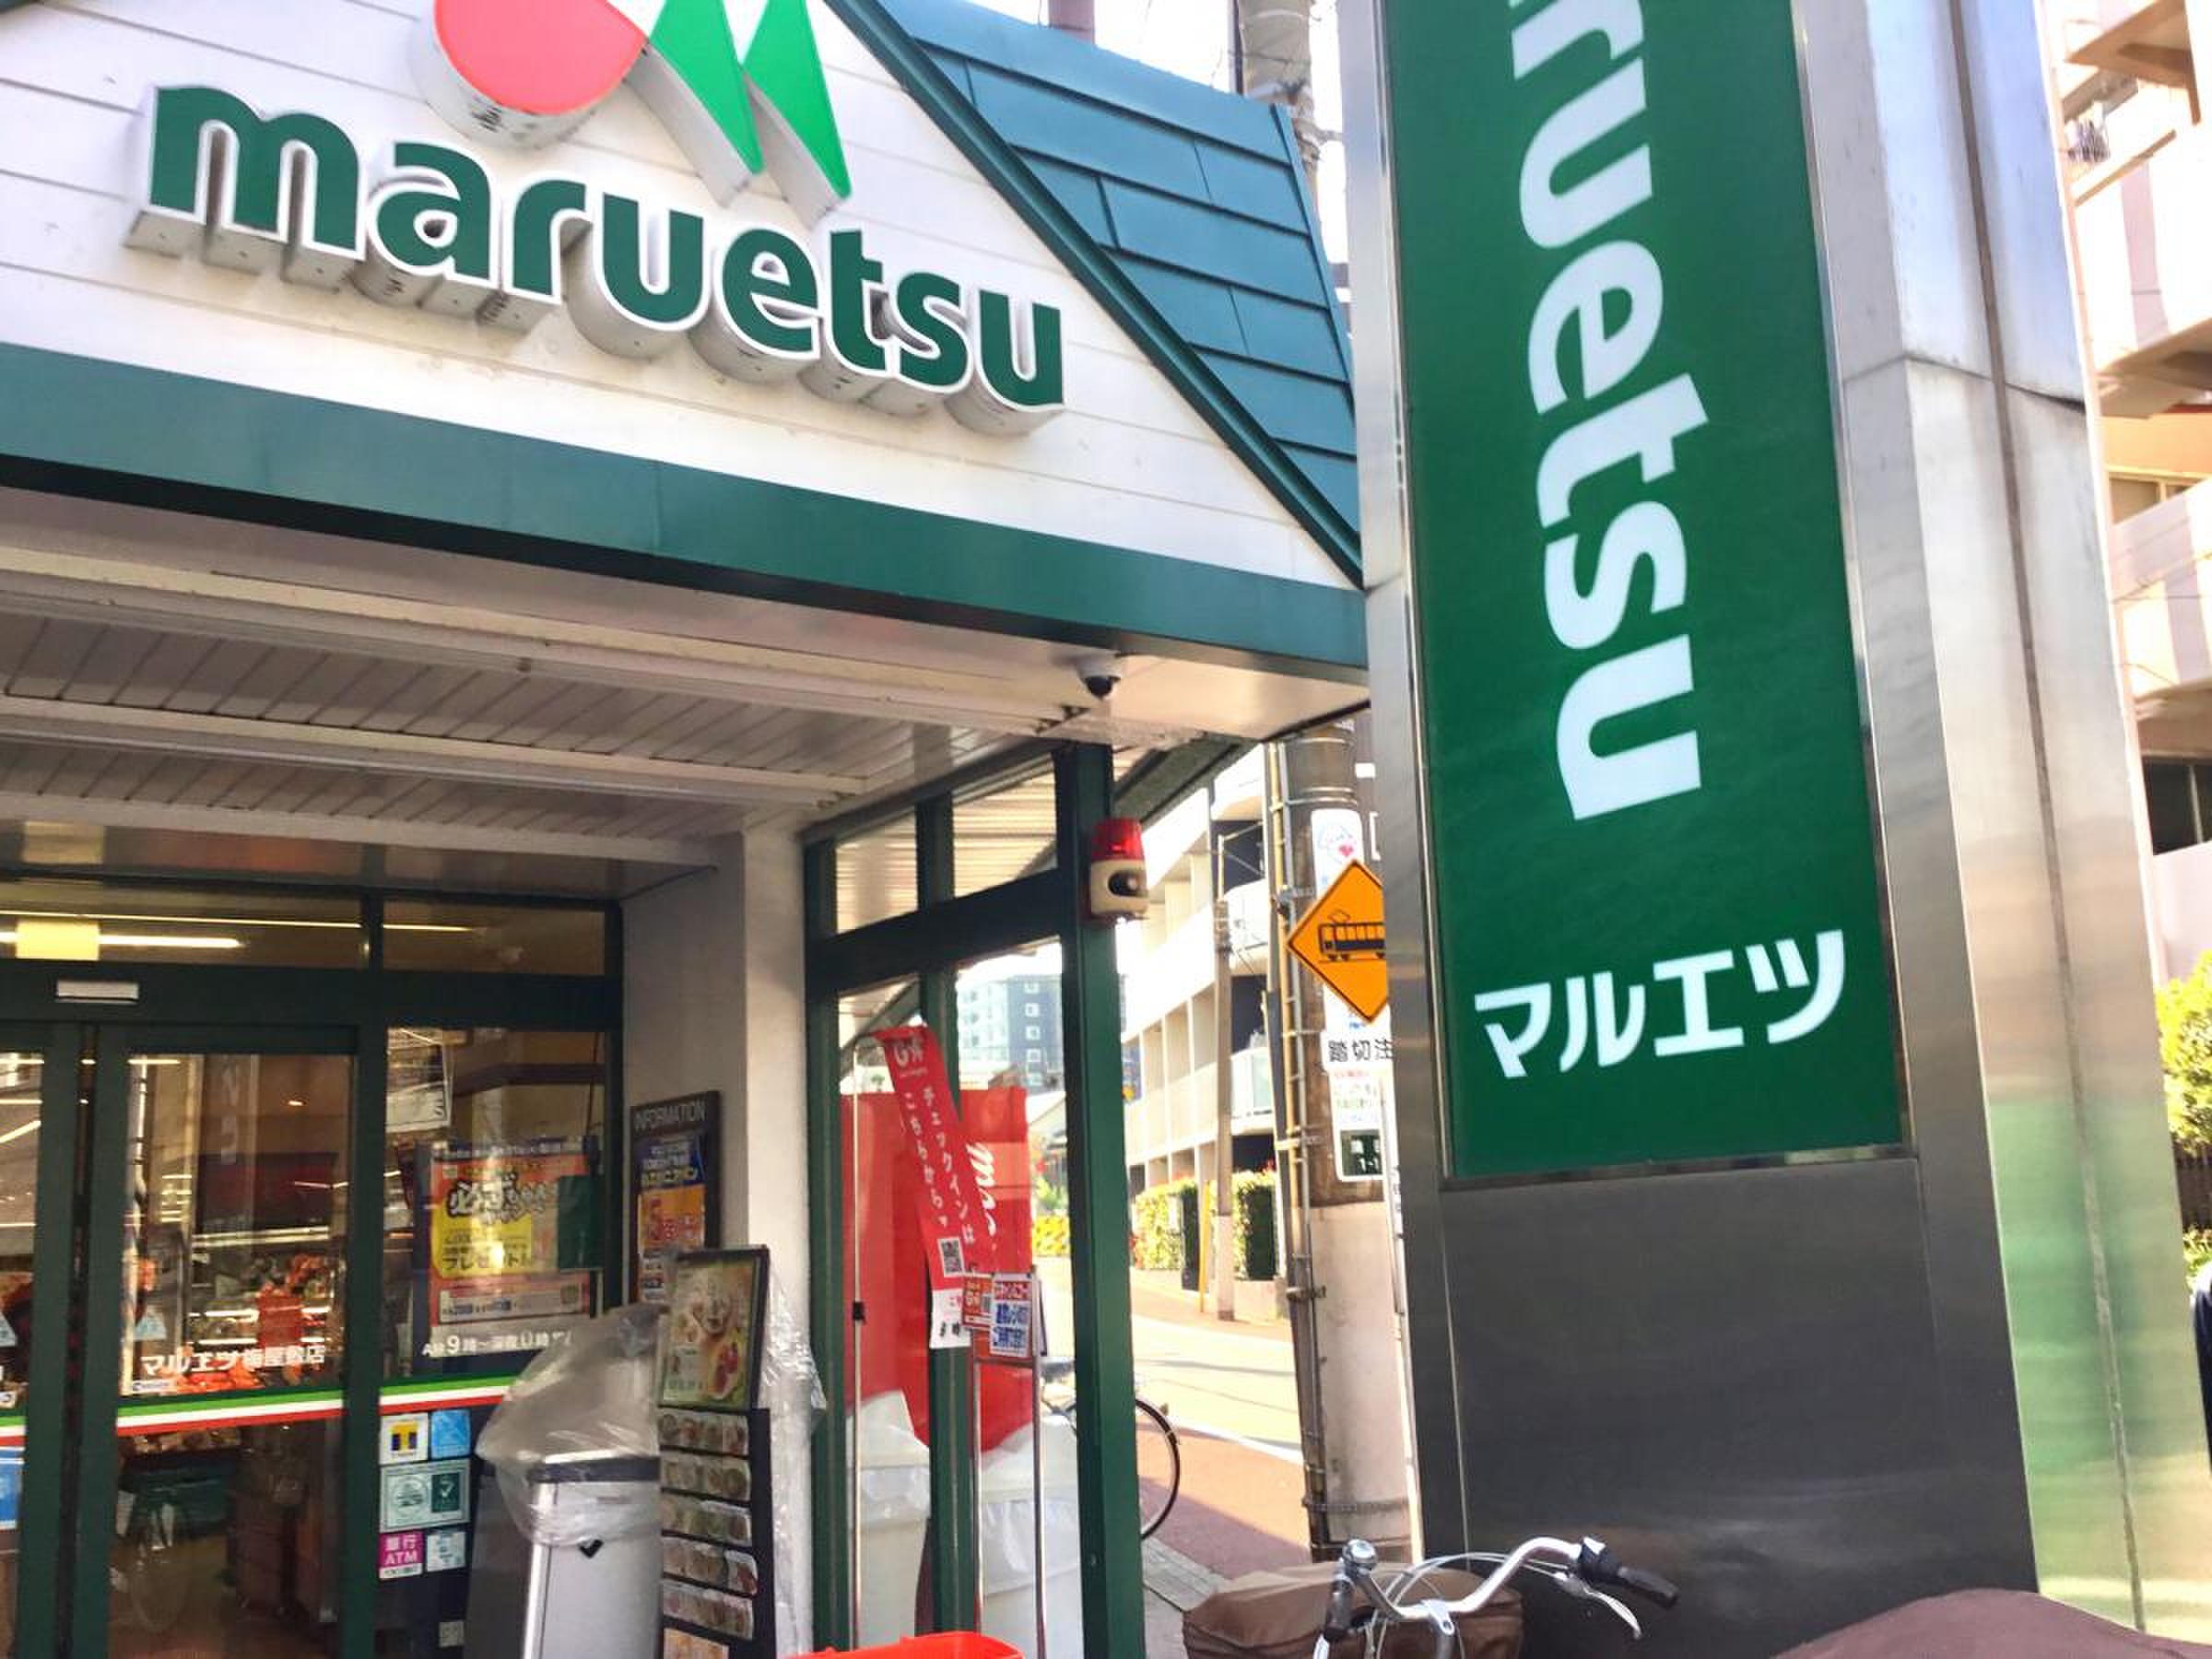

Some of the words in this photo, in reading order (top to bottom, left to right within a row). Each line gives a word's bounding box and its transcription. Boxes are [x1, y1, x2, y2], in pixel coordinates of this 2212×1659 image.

[152, 85, 1064, 407] maruetsu
[1508, 0, 1708, 819] ruetsu
[1474, 929, 1844, 1078] マルエツ
[384, 1550, 418, 1567] ATM
